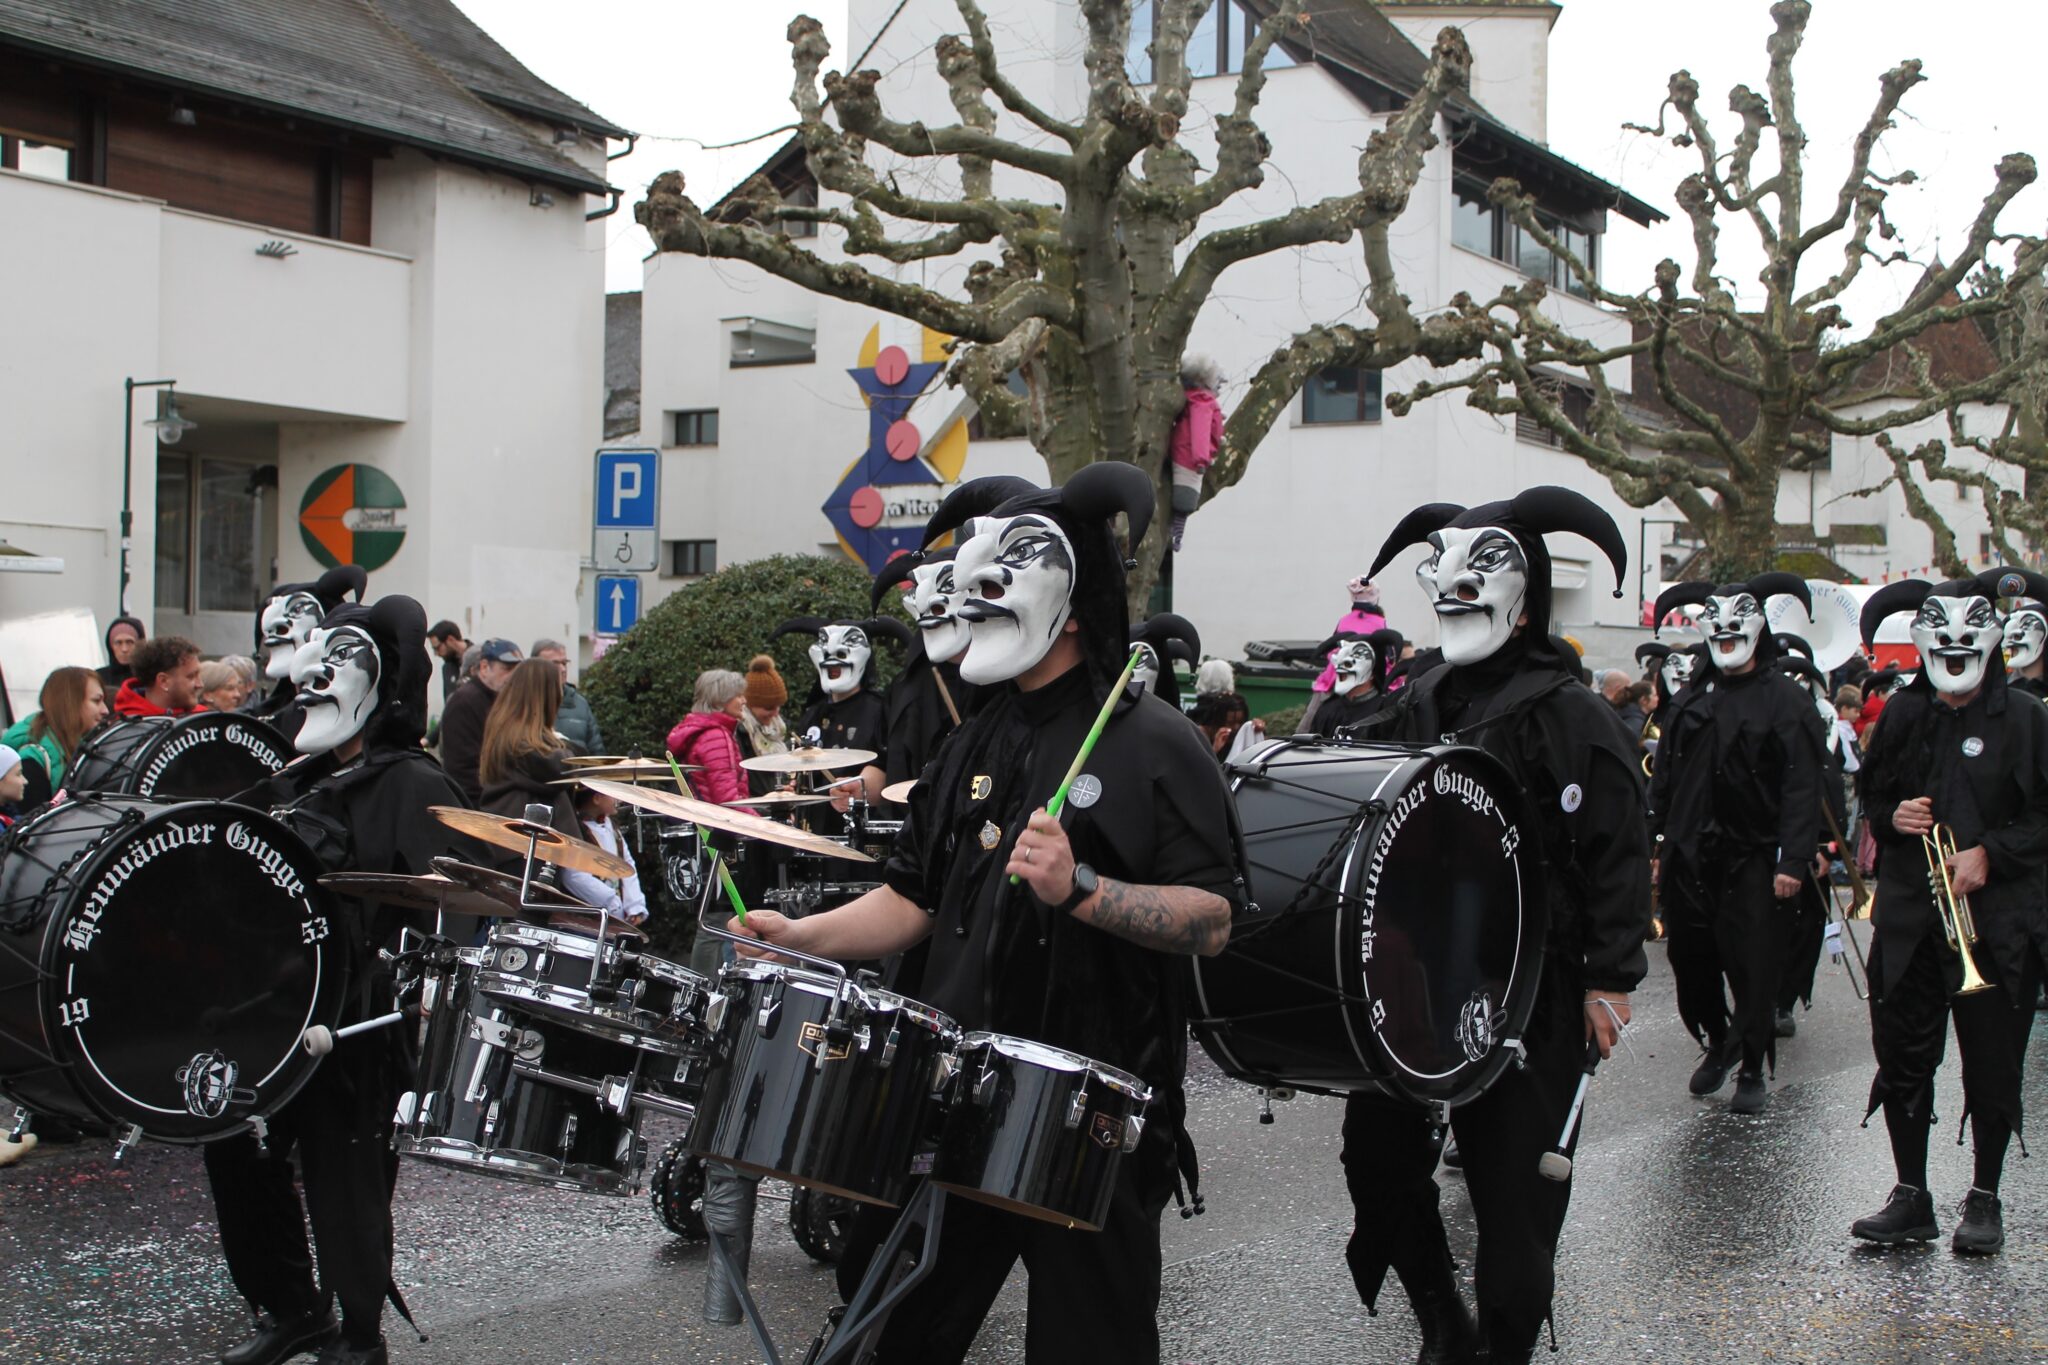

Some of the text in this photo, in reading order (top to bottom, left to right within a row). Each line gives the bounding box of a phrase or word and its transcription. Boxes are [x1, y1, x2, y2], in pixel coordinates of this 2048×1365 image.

[613, 463, 642, 518] P
[138, 724, 284, 799] euwänder Gugge
[1433, 763, 1494, 815] Gugge
[1501, 824, 1520, 859] 53
[62, 820, 304, 952] Heuwänder Gugge
[301, 915, 330, 947] 53
[58, 997, 91, 1029] 19
